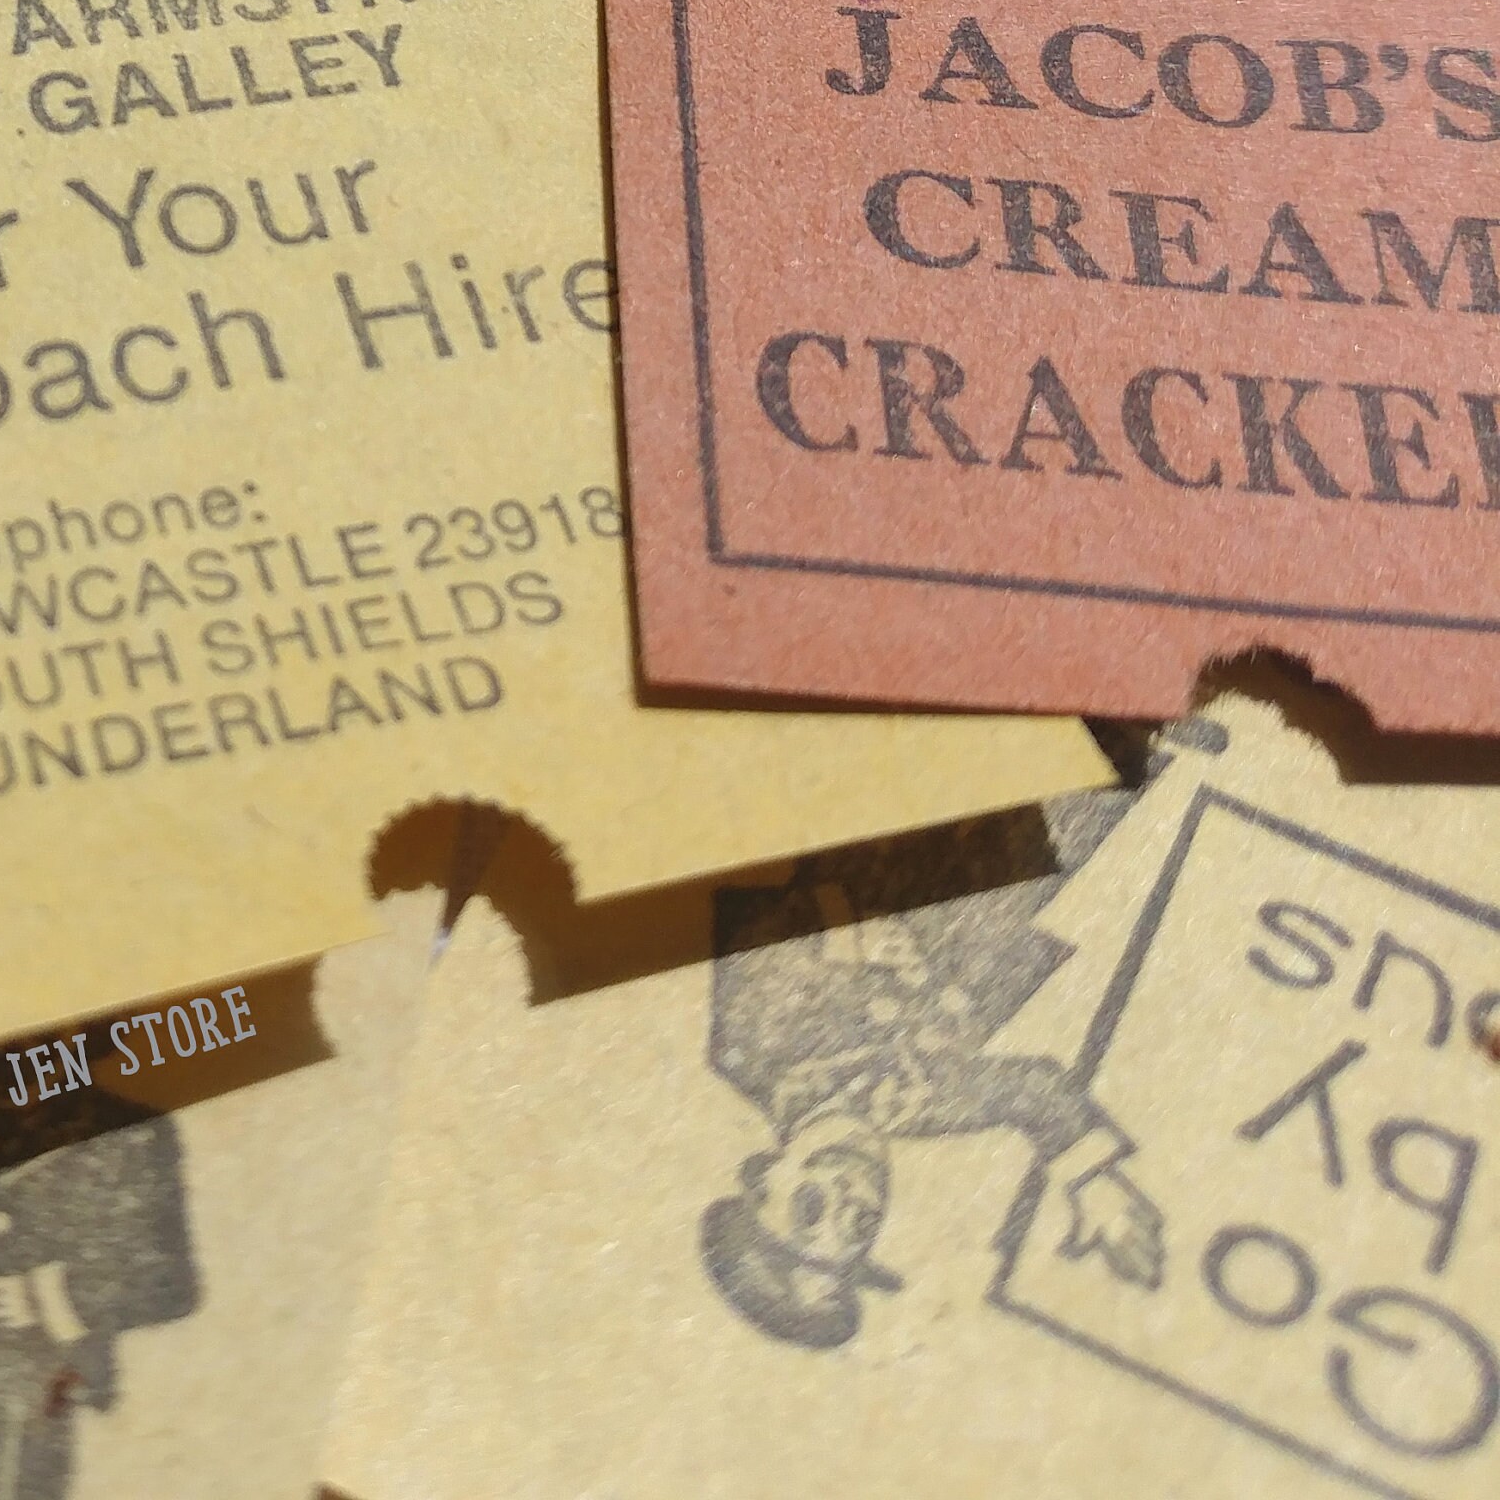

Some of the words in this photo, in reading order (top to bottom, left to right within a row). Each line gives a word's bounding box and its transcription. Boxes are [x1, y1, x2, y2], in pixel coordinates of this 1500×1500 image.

[28, 23, 404, 136] GALLEY
[825, 5, 1500, 143] JACOB'S
[67, 158, 378, 270] Your
[862, 168, 1500, 315] CREAM
[335, 251, 617, 372] Hire
[200, 569, 564, 677] SHIELDS
[1235, 1038, 1480, 1276] by
[1202, 1222, 1500, 1459] Go
